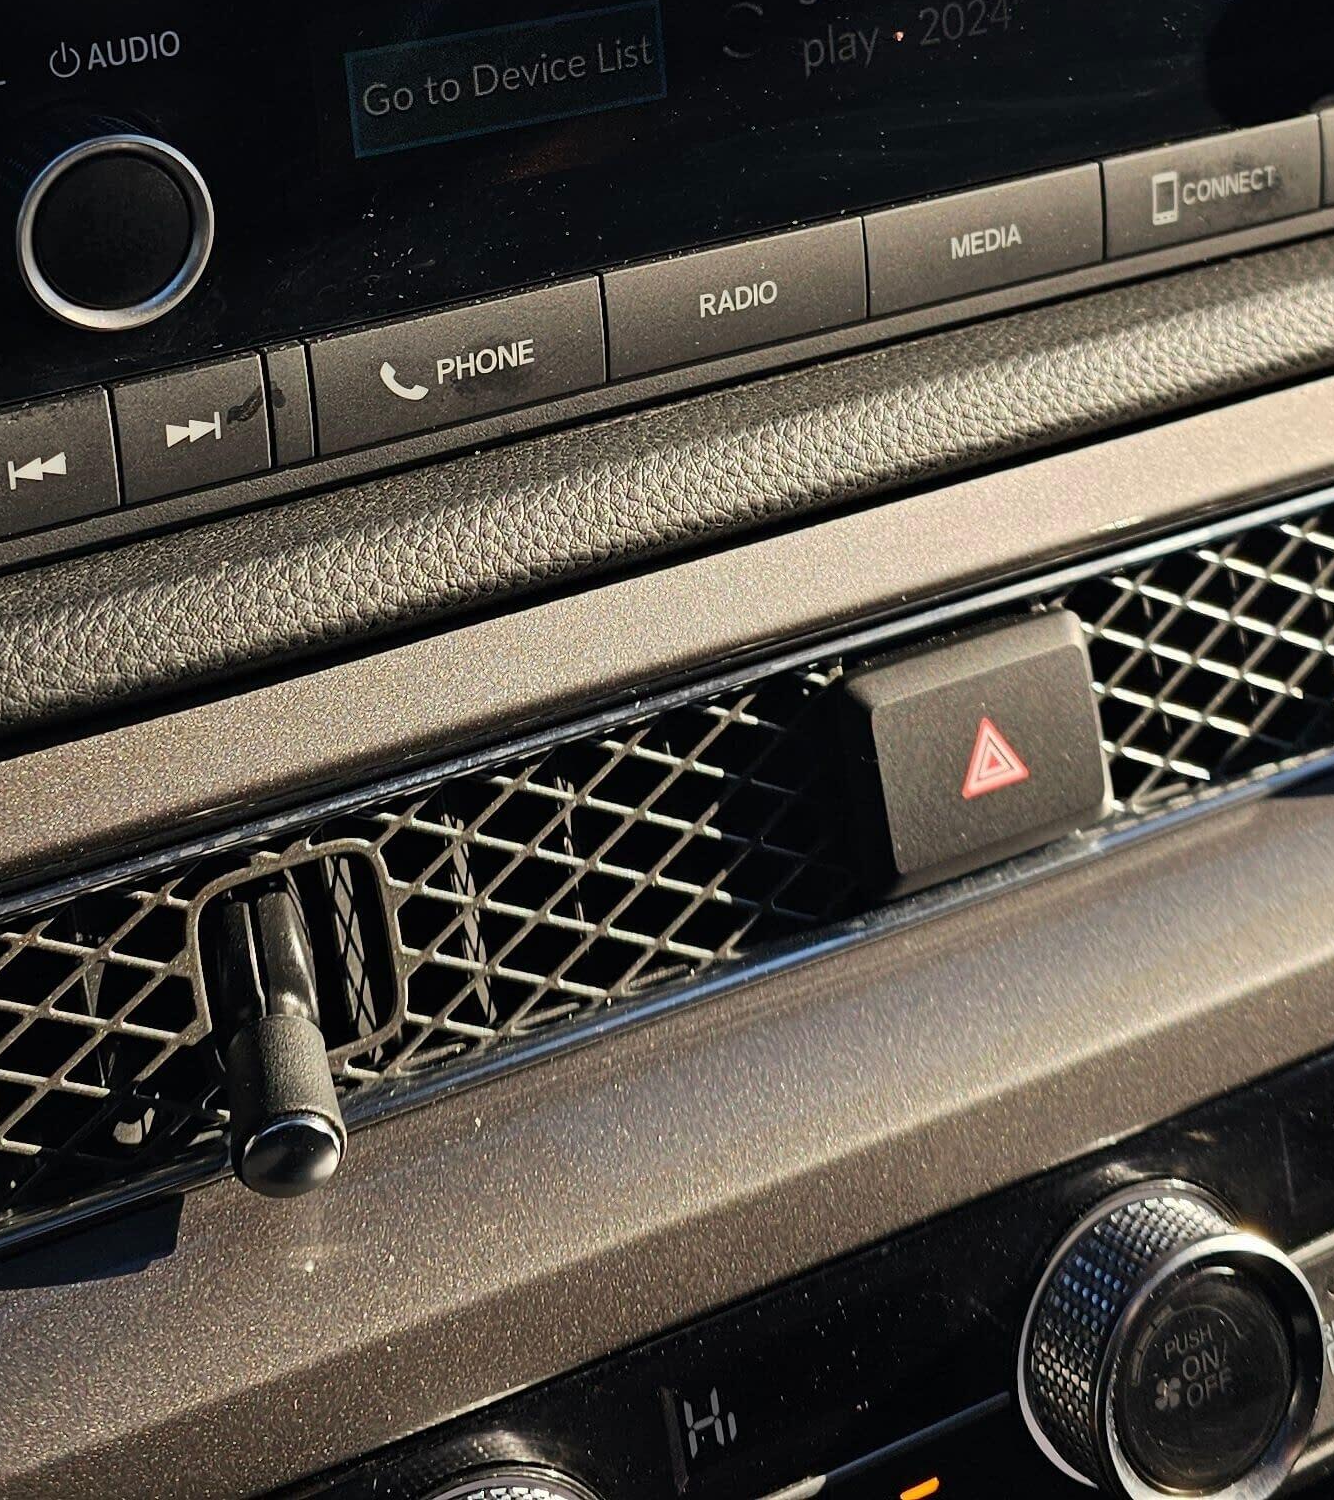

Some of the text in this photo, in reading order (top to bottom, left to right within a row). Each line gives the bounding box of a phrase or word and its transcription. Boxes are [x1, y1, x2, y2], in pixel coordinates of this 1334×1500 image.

[87, 30, 181, 72] AUDIO
[802, 21, 881, 81] play
[362, 34, 655, 117] Go to Device List
[1181, 164, 1277, 206] CONNECT
[949, 222, 1023, 261] MEDIA
[698, 279, 779, 319] RADIO
[436, 338, 536, 385] PHONE
[1164, 1323, 1214, 1361] PUSH
[1185, 1366, 1236, 1406] OFF
